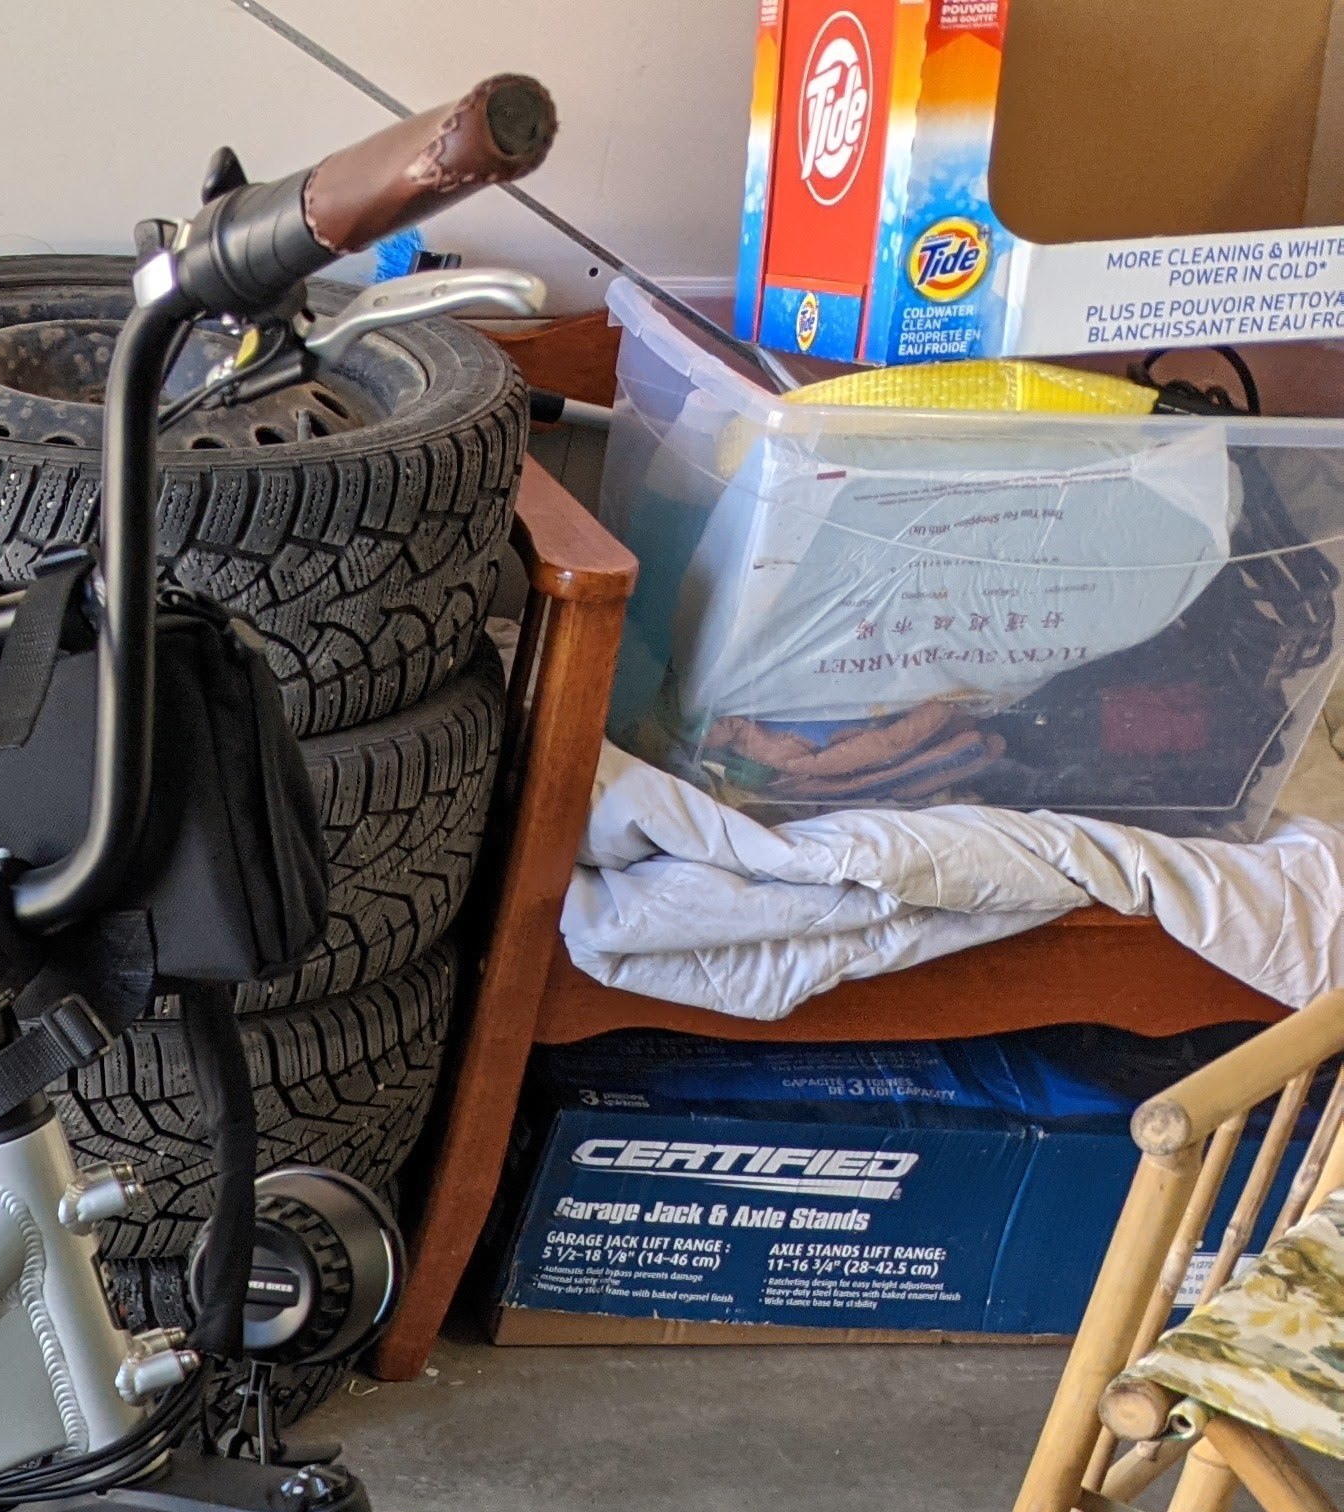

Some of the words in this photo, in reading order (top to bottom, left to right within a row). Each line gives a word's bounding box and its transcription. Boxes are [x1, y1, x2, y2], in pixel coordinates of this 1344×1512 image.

[801, 61, 868, 181] Tide
[916, 239, 981, 287] Tide
[1107, 250, 1161, 270] MORE
[1168, 243, 1264, 266] CLEANING
[1269, 242, 1283, 259] &
[1169, 267, 1238, 287] POWER
[1243, 265, 1262, 282] IN
[903, 305, 974, 319] COLDWATER
[1086, 303, 1135, 323] PLUS
[1140, 301, 1163, 319] DE
[1169, 296, 1256, 317] POUVOIR
[900, 328, 962, 344] PROPRETÉ
[965, 329, 981, 340] EN
[1088, 317, 1236, 344] BLANCHISSANT
[1238, 316, 1262, 334] EN
[1268, 314, 1307, 332] EAU
[898, 343, 923, 356] EAU
[925, 341, 967, 353] FROIDE
[814, 648, 997, 674] SUPERMARKET
[1006, 646, 1089, 663] LUCKY
[848, 1078, 864, 1096] 3
[579, 1089, 599, 1106] 3
[571, 1139, 920, 1179] CERTIFIED
[554, 1197, 640, 1224] Garage
[644, 1202, 701, 1226] Jack
[709, 1204, 728, 1226] &
[731, 1205, 785, 1229] Axle
[790, 1208, 871, 1231] Stands
[547, 1231, 604, 1247] GARAGE
[604, 1235, 639, 1249] JACK
[643, 1236, 670, 1250] LIFT
[542, 1246, 551, 1259] 5
[692, 1255, 720, 1271] cm)
[769, 1243, 804, 1257] AXLE
[806, 1244, 860, 1258] STANDS
[863, 1246, 891, 1259] LIFT
[894, 1247, 947, 1260] RANGE:
[544, 1266, 584, 1275] Automatic
[634, 1270, 668, 1280] prevents
[670, 1272, 703, 1282] damage
[910, 1262, 939, 1279] cm)
[768, 1278, 809, 1288] Ratcheting
[812, 1279, 837, 1289] design
[839, 1280, 850, 1288] for
[852, 1281, 870, 1290] easy
[872, 1280, 898, 1291] height
[899, 1281, 944, 1291] adjustment
[632, 1288, 650, 1298] with
[652, 1290, 677, 1300] baked
[711, 1294, 733, 1303] finish
[764, 1297, 784, 1306] Wide
[813, 1299, 831, 1307] base
[812, 1288, 831, 1297] steel
[862, 1290, 879, 1299] with
[881, 1291, 906, 1300] baked
